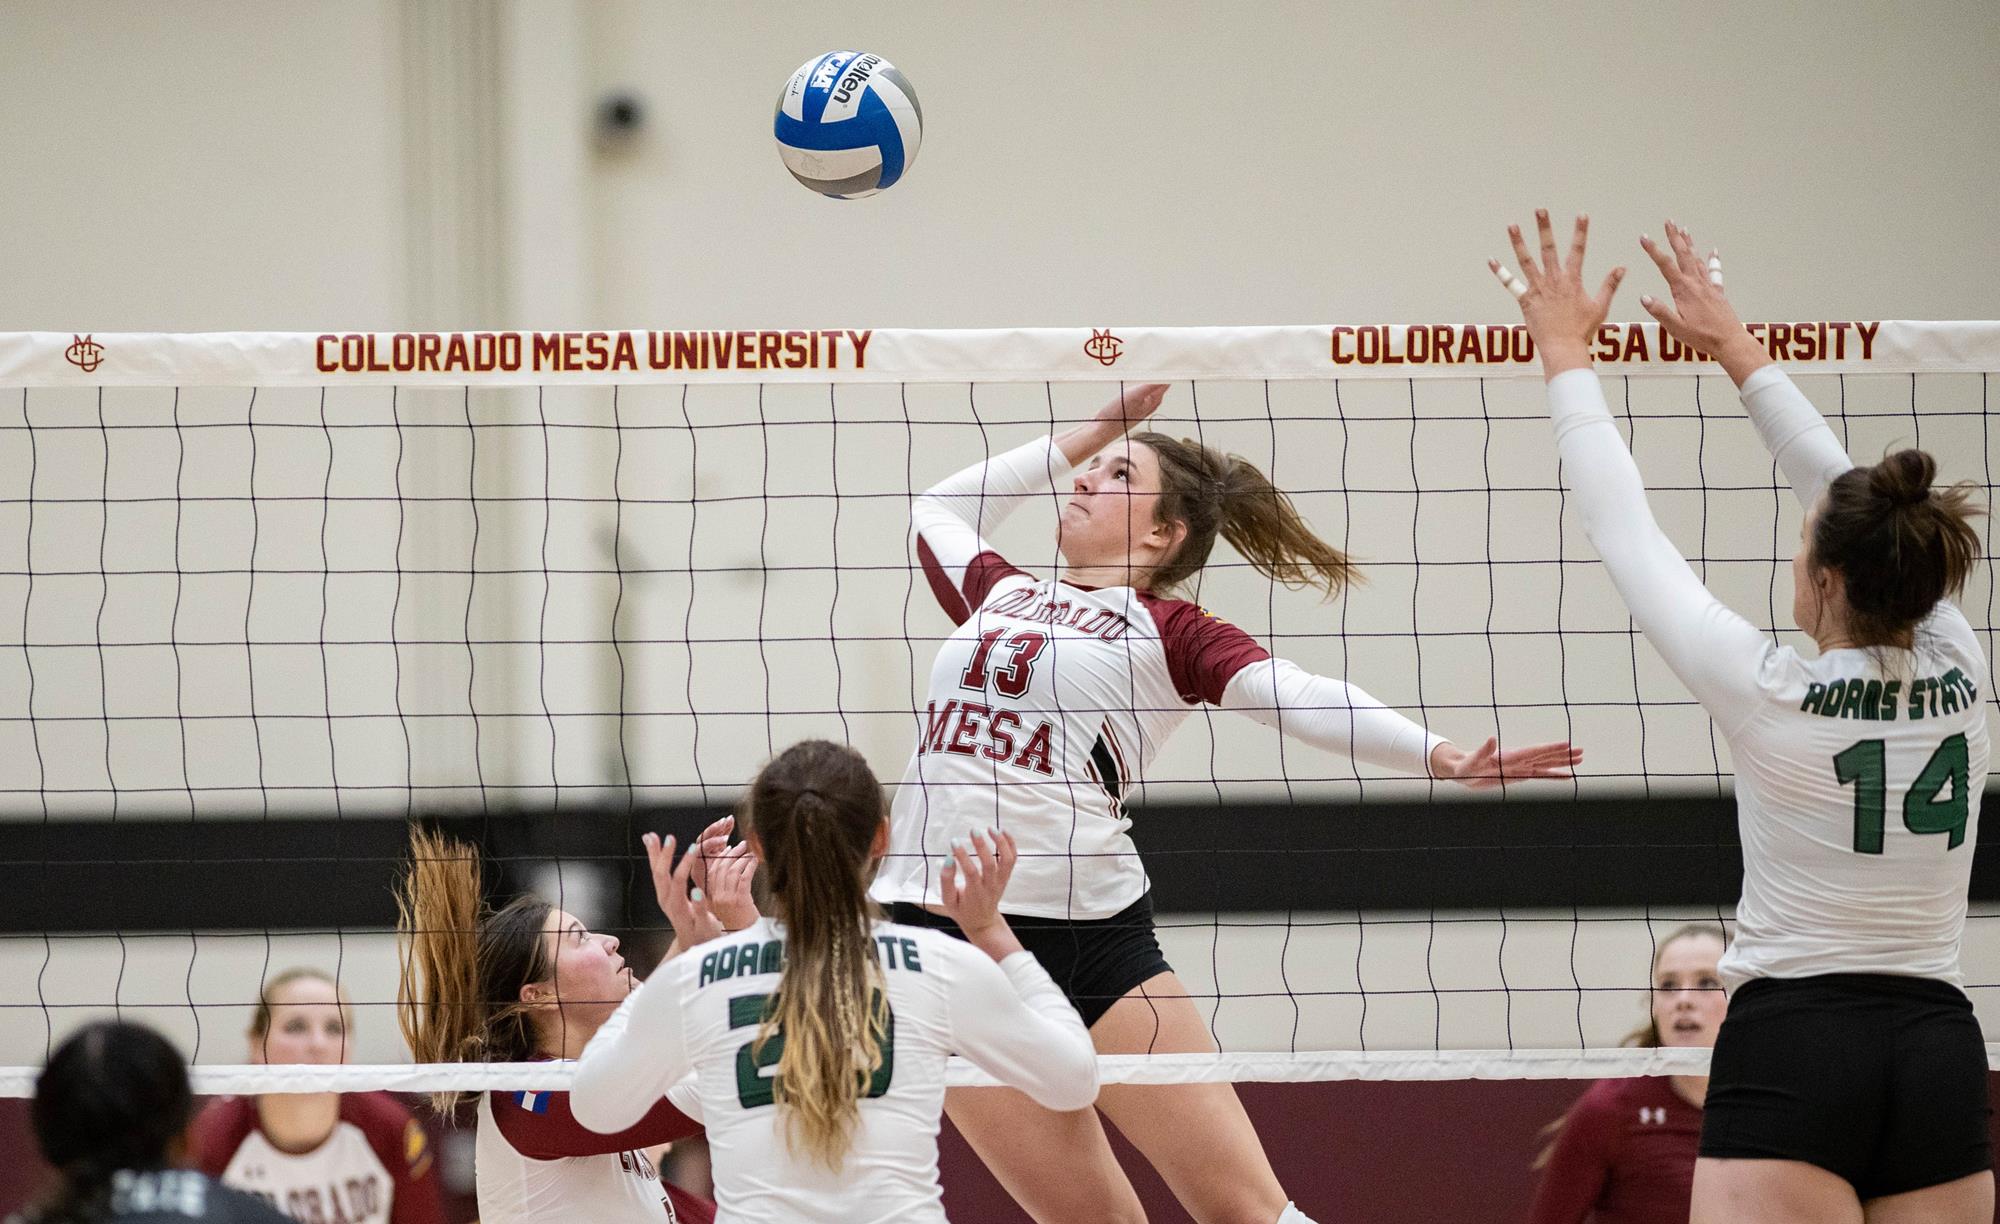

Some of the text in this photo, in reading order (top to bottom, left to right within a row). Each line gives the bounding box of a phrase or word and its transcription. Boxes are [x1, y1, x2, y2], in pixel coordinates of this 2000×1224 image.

[833, 54, 881, 104] molten
[315, 329, 873, 372] COLORADO MESA UNIVERSITY
[1331, 321, 1881, 364] COLORADO SA URSITY
[959, 627, 1048, 700] 13
[1800, 665, 1978, 721] ADAMS STATE
[917, 698, 1055, 778] MESA
[1832, 731, 1970, 855] 14
[699, 939, 783, 988] ADAM
